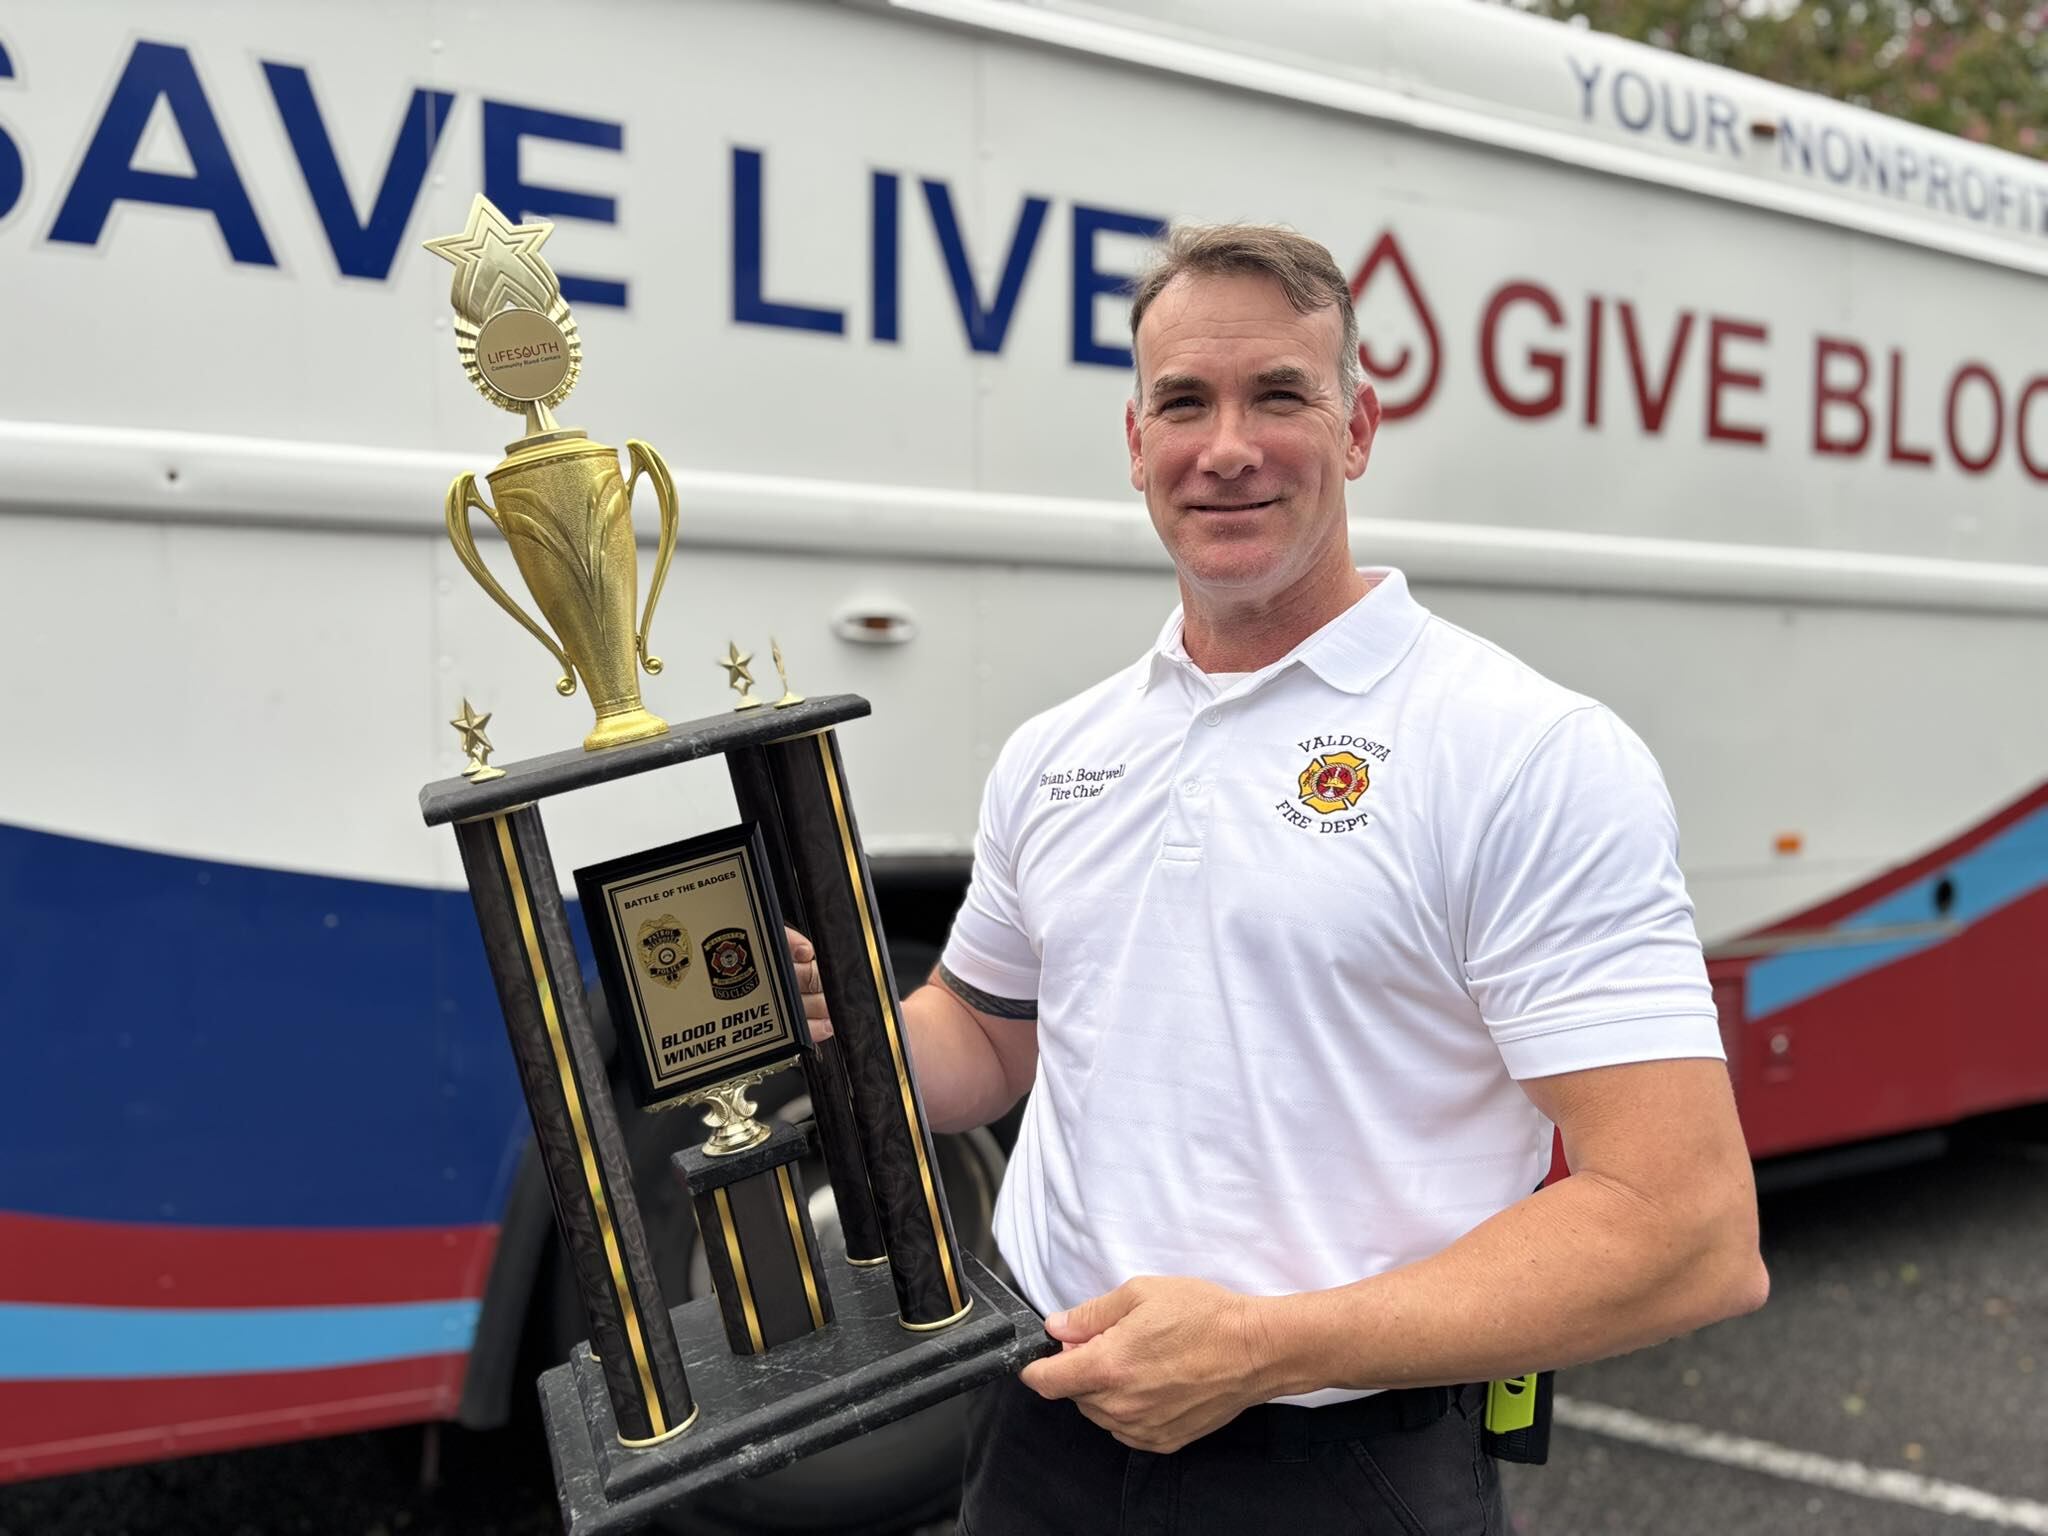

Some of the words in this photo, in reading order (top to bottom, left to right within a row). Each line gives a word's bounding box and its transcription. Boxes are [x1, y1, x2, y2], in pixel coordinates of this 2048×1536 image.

[1566, 53, 1742, 157] YOUR
[0, 39, 628, 309] AVE
[1478, 281, 1771, 448] GIVE
[487, 341, 560, 365] LIFESOUTH
[491, 361, 523, 372] Community
[1298, 735, 1392, 762] VALDOSTA
[1039, 771, 1065, 788] Brian
[1065, 769, 1074, 783] S.
[1075, 763, 1126, 782] Boutwell
[1049, 787, 1072, 801] Fire
[1072, 783, 1105, 799] Chief
[1275, 800, 1313, 829] FIRE
[1319, 813, 1369, 834] DEPT
[624, 893, 661, 910] BATTLE
[662, 888, 676, 899] OF
[676, 883, 696, 894] THE
[697, 870, 737, 888] BADGES
[661, 1021, 717, 1050] BLOOD
[721, 1003, 770, 1030] DRIVE
[664, 1035, 727, 1066] WINNER
[732, 1019, 774, 1044] 2025
